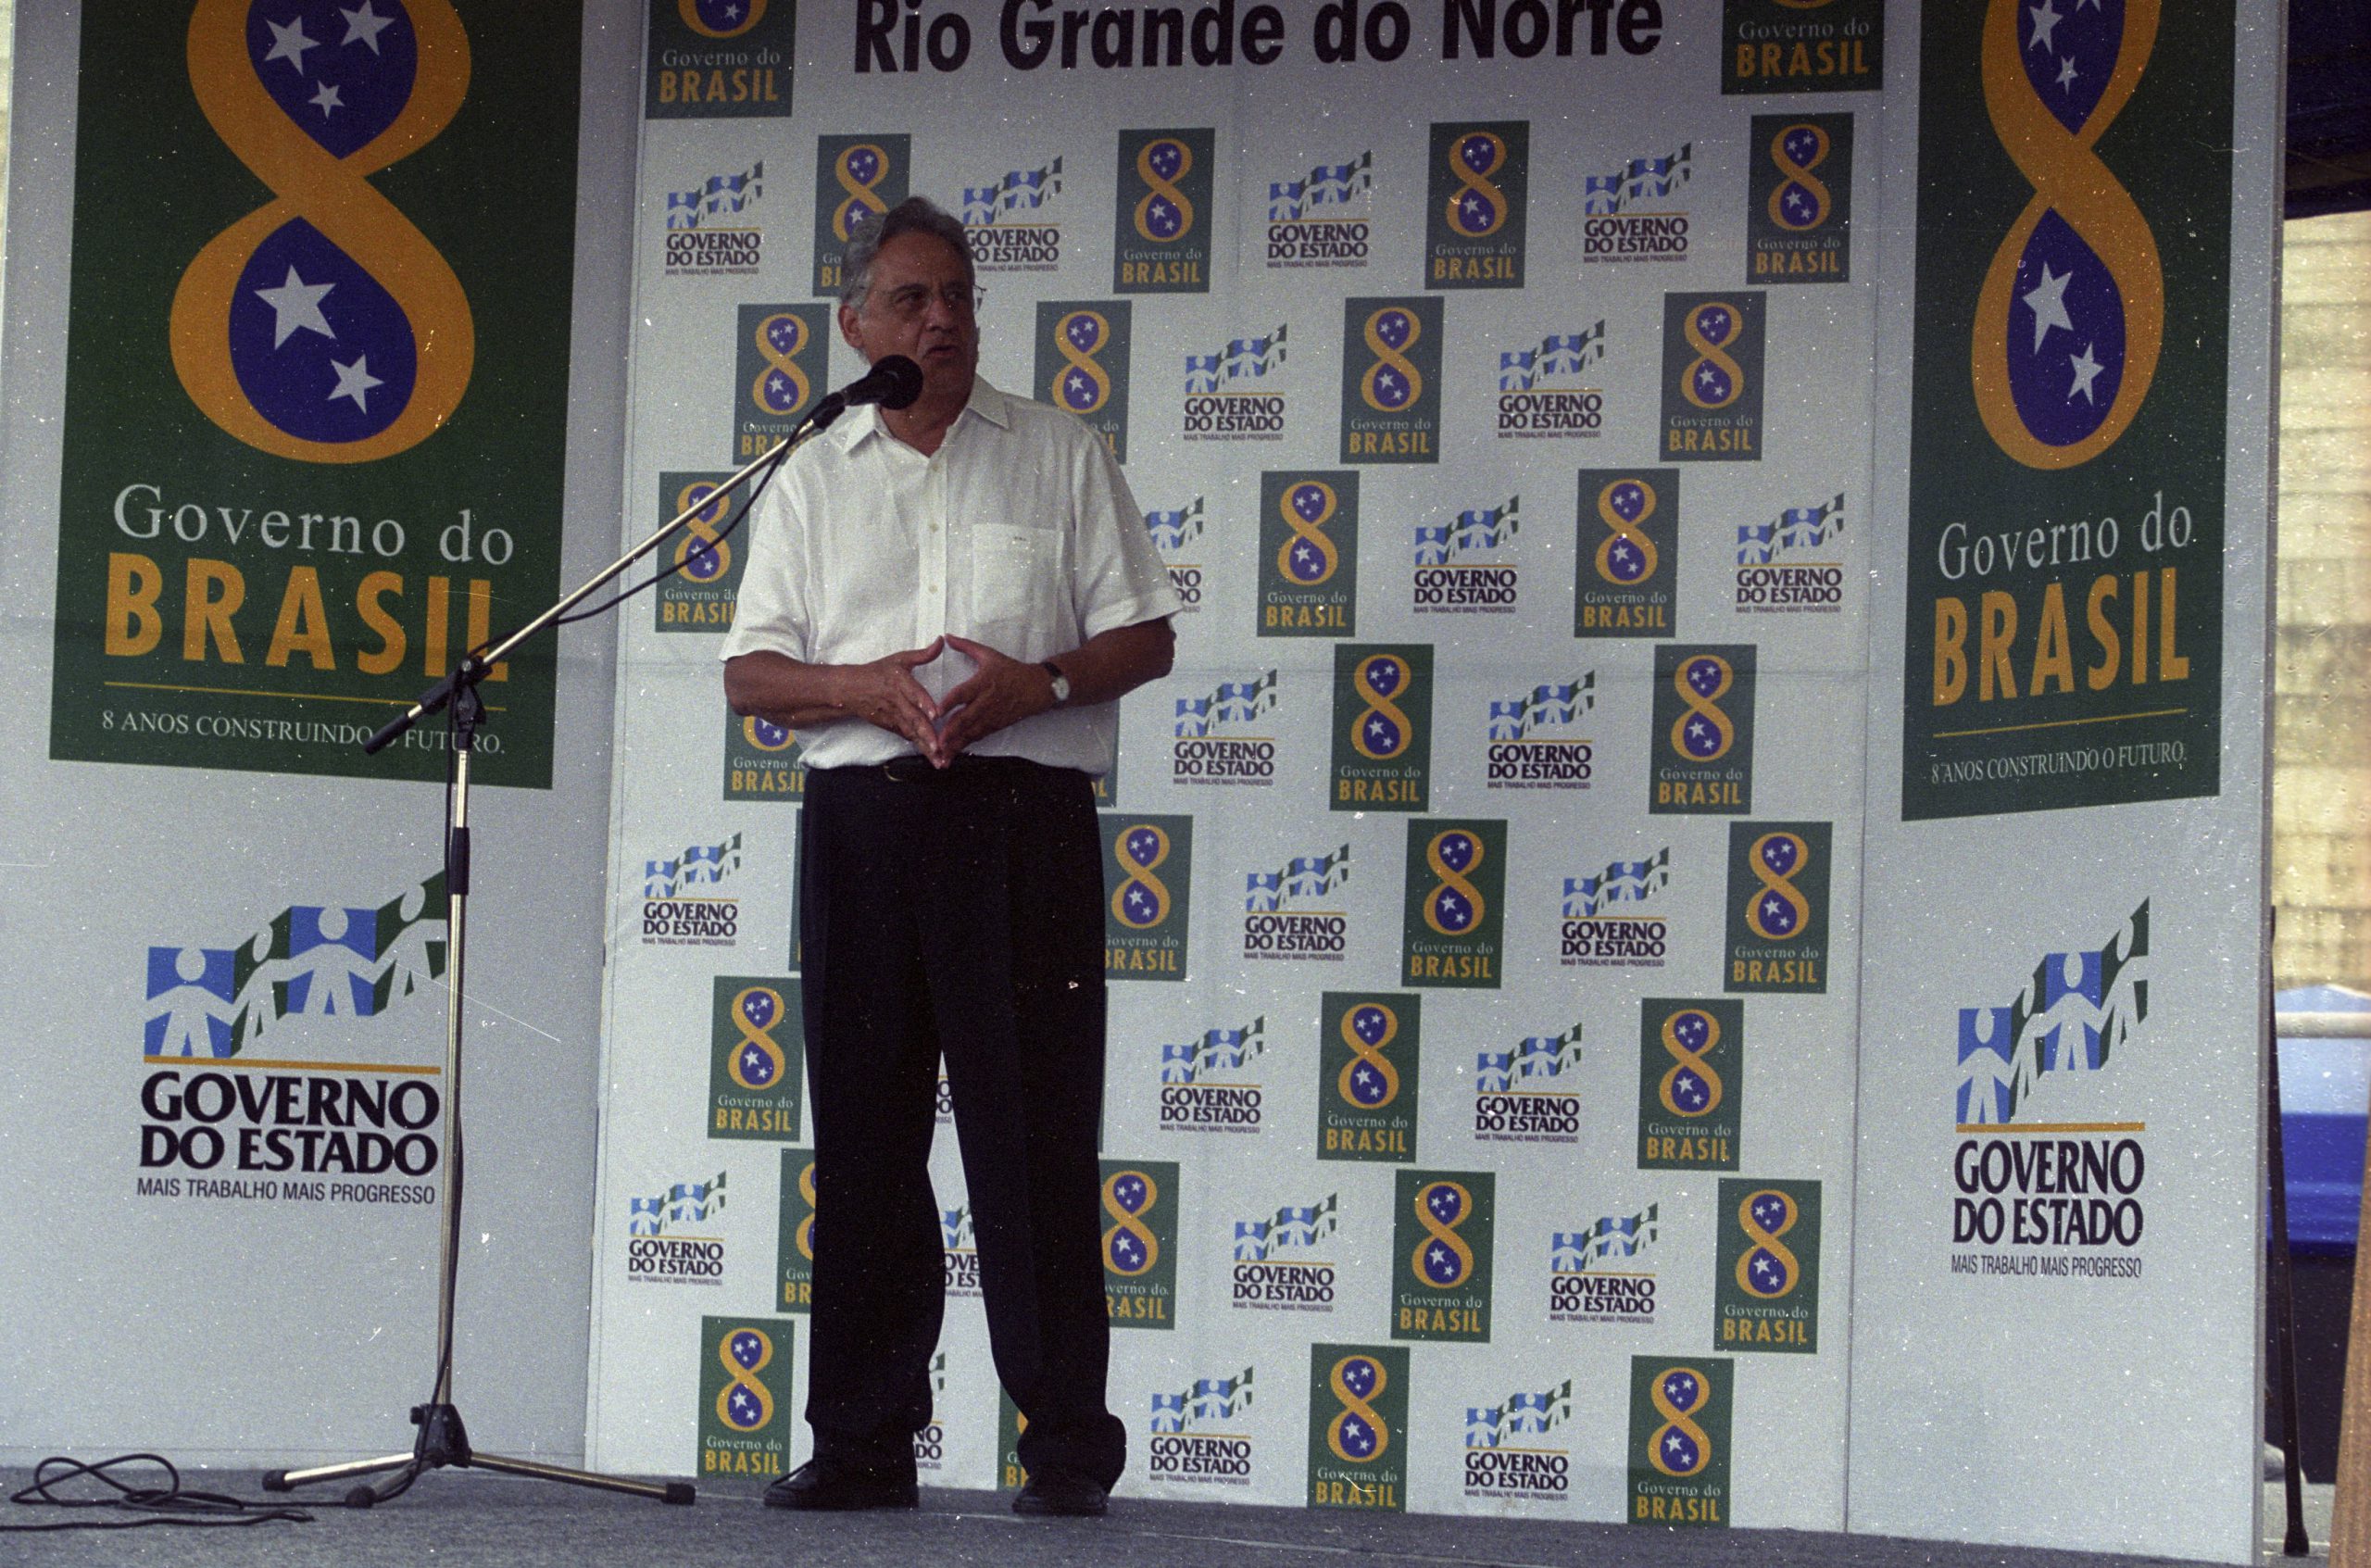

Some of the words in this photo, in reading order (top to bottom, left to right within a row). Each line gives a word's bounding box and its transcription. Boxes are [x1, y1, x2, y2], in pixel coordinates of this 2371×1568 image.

[853, 0, 970, 73] Rio
[1000, 0, 1286, 71] Grande
[1313, 0, 1411, 64] do
[1442, 0, 1663, 59] Norte
[1737, 20, 1835, 40] Governo
[1843, 18, 1870, 36] do
[662, 48, 746, 68] Governo
[755, 47, 781, 66] do
[1736, 40, 1868, 78] BRASIL
[659, 69, 778, 103] BRASIL
[1269, 224, 1368, 243] GOVERNO
[1585, 218, 1688, 237] GOVERNO
[667, 232, 760, 251] GOVERNO
[1269, 242, 1297, 258] DO
[1300, 242, 1368, 258] ESTADO
[1436, 243, 1494, 256] Governo
[1498, 244, 1515, 256] do
[1585, 236, 1613, 253] DO
[1618, 236, 1687, 253] ESTADO
[1757, 237, 1817, 250] Governo
[1823, 238, 1840, 250] do
[667, 250, 693, 266] DO
[696, 250, 759, 266] ESTADO
[1123, 247, 1181, 260] Governo
[1186, 248, 1202, 260] do
[1756, 251, 1838, 274] BRASIL
[1123, 261, 1200, 282] BRASIL
[1435, 257, 1513, 281] BRASIL
[1185, 397, 1284, 416] GOVERNO
[1499, 395, 1601, 413] GOVERNO
[1185, 415, 1212, 431] DO
[1216, 415, 1284, 431] ESTADO
[1350, 417, 1409, 430] Governo
[1413, 418, 1431, 430] do
[1499, 412, 1528, 429] DO
[1532, 412, 1601, 429] ESTADO
[1670, 415, 1731, 428] Governo
[1736, 416, 1753, 428] do
[1349, 431, 1429, 455] BRASIL
[1669, 429, 1751, 451] BRASIL
[114, 483, 406, 557] Governo
[439, 509, 514, 565] do
[1938, 517, 2119, 580] Governo
[2140, 490, 2192, 552] do
[1415, 570, 1516, 588] GOVERNO
[1737, 569, 1842, 587] GOVERNO
[665, 589, 719, 601] Governo
[1267, 591, 1325, 604] Governo
[1330, 592, 1348, 604] do
[1415, 587, 1444, 603] DO
[1448, 587, 1516, 603] ESTADO
[1585, 591, 1645, 604] Governo
[1650, 592, 1667, 604] do
[1737, 586, 1766, 603] DO
[1771, 586, 1841, 603] ESTADO
[105, 552, 508, 683] BRASIL
[1266, 605, 1346, 627] BRASIL
[1584, 605, 1665, 628] BRASIL
[1933, 567, 2189, 707] BRASIL
[102, 710, 114, 729] 8
[121, 712, 190, 736] ANOS
[195, 715, 374, 746] CONSTRUINDO
[1175, 742, 1274, 760] GOVERNO
[1489, 745, 1591, 763] GOVERNO
[733, 757, 788, 769] Governo
[1175, 759, 1203, 776] DO
[1207, 759, 1273, 776] ESTADO
[1340, 765, 1399, 778] Governo
[1403, 766, 1421, 778] do
[1489, 762, 1518, 779] DO
[1522, 762, 1591, 779] ESTADO
[1931, 767, 1940, 785] 8
[1942, 759, 1984, 784] ANOS
[1988, 749, 2099, 782] CONSTRUINDO
[2103, 747, 2114, 769] O
[1660, 768, 1720, 781] Governo
[1725, 769, 1742, 781] do
[1339, 779, 1419, 801] BRASIL
[1659, 782, 1740, 805] BRASIL
[644, 902, 737, 921] GOVERNO
[644, 920, 670, 936] DO
[673, 920, 736, 936] ESTADO
[1246, 916, 1346, 935] GOVERNO
[1562, 922, 1665, 941] GOVERNO
[1246, 935, 1273, 951] DO
[1277, 935, 1345, 951] ESTADO
[1411, 940, 1471, 952] Governo
[1476, 942, 1494, 954] do
[1562, 940, 1591, 957] DO
[1596, 940, 1665, 957] ESTADO
[1735, 946, 1796, 958] Governo
[1800, 947, 1818, 960] do
[1411, 954, 1492, 978] BRASIL
[1734, 960, 1816, 984] BRASIL
[141, 1071, 441, 1130] GOVERNO
[717, 1094, 772, 1106] Governo
[776, 1097, 793, 1109] do
[1476, 1097, 1579, 1116] GOVERNO
[716, 1108, 791, 1132] BRASIL
[1327, 1114, 1386, 1126] Governo
[1389, 1117, 1407, 1129] do
[1476, 1115, 1505, 1133] DO
[1509, 1115, 1578, 1133] ESTADO
[1648, 1123, 1709, 1135] Governo
[1713, 1125, 1731, 1137] do
[1326, 1128, 1405, 1152] BRASIL
[1647, 1136, 1729, 1161] BRASIL
[140, 1125, 224, 1170] DO
[238, 1128, 438, 1176] ESTADO
[1954, 1138, 2145, 1196] GOVERNO
[137, 1177, 181, 1198] MAIS
[186, 1179, 278, 1200] TRABALHO
[282, 1182, 326, 1202] MAIS
[331, 1184, 435, 1205] PROGRESSO
[1952, 1198, 2005, 1245] DO
[2013, 1198, 2144, 1247] ESTADO
[630, 1240, 723, 1260] GOVERNO
[629, 1259, 655, 1275] DO
[659, 1259, 722, 1275] ESTADO
[1234, 1265, 1334, 1285] GOVERNO
[1951, 1254, 1978, 1275] MAIS
[1981, 1255, 2038, 1277] TRABALHO
[2040, 1256, 2069, 1277] MAIS
[2072, 1257, 2141, 1279] PROGRESSO
[1234, 1284, 1261, 1301] DO
[1266, 1284, 1334, 1301] ESTADO
[1551, 1276, 1655, 1297] GOVERNO
[1401, 1294, 1460, 1306] Governo
[1465, 1297, 1483, 1309] do
[1551, 1296, 1580, 1313] DO
[1585, 1296, 1654, 1313] ESTADO
[1400, 1308, 1481, 1332] BRASIL
[1723, 1305, 1786, 1317] Governo
[1790, 1308, 1809, 1320] do
[1722, 1319, 1807, 1344] BRASIL
[707, 1435, 761, 1447] Governo
[765, 1437, 782, 1449] do
[706, 1449, 780, 1474] BRASIL
[1466, 1452, 1568, 1473] GOVERNO
[1466, 1472, 1495, 1490] DO
[1499, 1472, 1568, 1490] ESTADO
[1637, 1483, 1698, 1495] Governo
[1703, 1486, 1721, 1498] do
[1637, 1497, 1719, 1522] BRASIL
